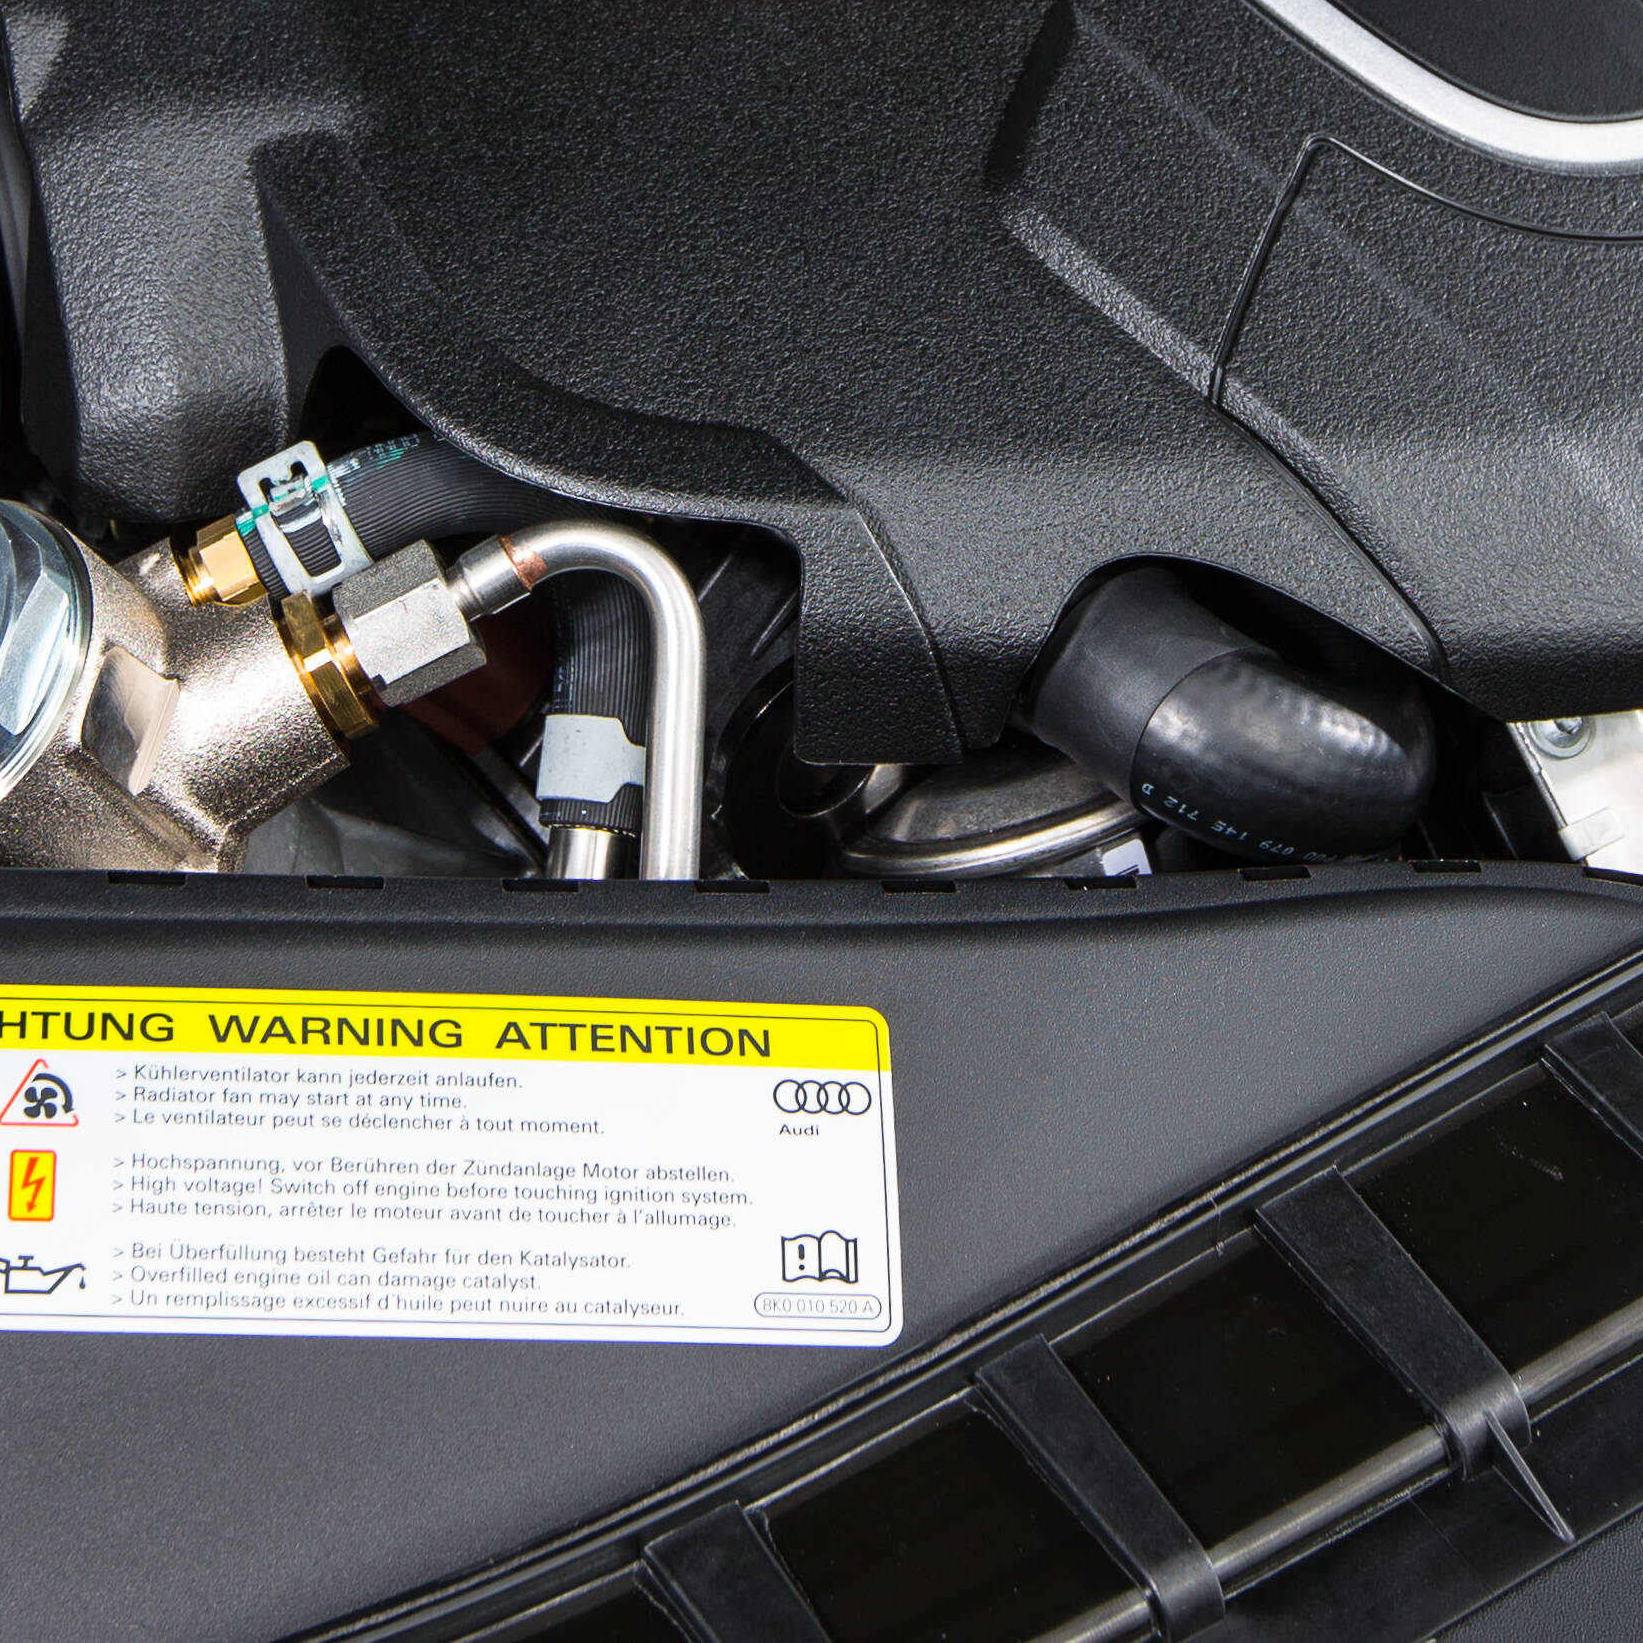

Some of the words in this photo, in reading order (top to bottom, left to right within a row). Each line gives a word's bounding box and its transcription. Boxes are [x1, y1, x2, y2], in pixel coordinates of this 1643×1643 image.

[208, 1014, 463, 1049] WARNING
[494, 1021, 771, 1057] ATTENTION
[134, 1063, 291, 1084] Kühlerventilator
[296, 1067, 342, 1085] kann
[348, 1068, 429, 1089] jederzeit
[435, 1071, 523, 1089] anlaufen.
[133, 1085, 216, 1104] Radiator
[222, 1087, 252, 1104] fan
[259, 1092, 301, 1109] may
[306, 1091, 349, 1107] start
[355, 1092, 373, 1108] at
[378, 1094, 414, 1112] any
[419, 1092, 467, 1109] time.
[133, 1108, 156, 1125] Le
[161, 1108, 266, 1127] ventilateur
[272, 1113, 315, 1131] peut
[321, 1115, 342, 1128] se
[348, 1112, 453, 1131] déclencher
[459, 1115, 470, 1132] à
[476, 1117, 514, 1133] tout
[520, 1120, 605, 1134] moment.
[778, 1123, 820, 1137] Audi
[292, 1159, 324, 1173] vor
[330, 1156, 419, 1174] Berühren
[425, 1158, 457, 1176] der
[462, 1159, 576, 1182] Zündanlage
[582, 1162, 640, 1180] Motor
[645, 1164, 734, 1182] abstellen.
[131, 1174, 176, 1196] High
[270, 1177, 336, 1196] Switch
[342, 1179, 369, 1197] off
[374, 1180, 440, 1201] engine
[446, 1181, 508, 1200] before
[513, 1183, 598, 1205] touching
[604, 1185, 675, 1206] ignition
[681, 1190, 753, 1208] system.
[130, 1197, 188, 1216] Haute
[278, 1201, 344, 1219] arrêter
[351, 1202, 367, 1219] le
[374, 1205, 444, 1221] moteur
[450, 1206, 502, 1222] avant
[508, 1205, 532, 1222] de
[537, 1207, 611, 1224] toucher
[616, 1208, 627, 1225] à
[131, 1241, 162, 1259] Bei
[169, 1240, 287, 1266] Überfüllung
[294, 1245, 365, 1263] besteht
[372, 1246, 438, 1265] Gefahr
[444, 1247, 471, 1266] für
[477, 1249, 513, 1266] den
[519, 1249, 630, 1272] Katalysator.
[130, 1264, 227, 1284] Overfilled
[233, 1268, 301, 1289] engine
[307, 1269, 330, 1286] oil
[337, 1273, 371, 1286] can
[377, 1270, 457, 1293] damage
[462, 1272, 541, 1294] catalyst.
[130, 1289, 158, 1306] Un
[165, 1290, 286, 1313] remplissage
[292, 1292, 371, 1310] excessif
[450, 1297, 492, 1315] peut
[499, 1300, 549, 1313] nuire
[554, 1300, 577, 1314] au
[583, 1298, 684, 1319] catalyseur.
[863, 1299, 875, 1315] A
